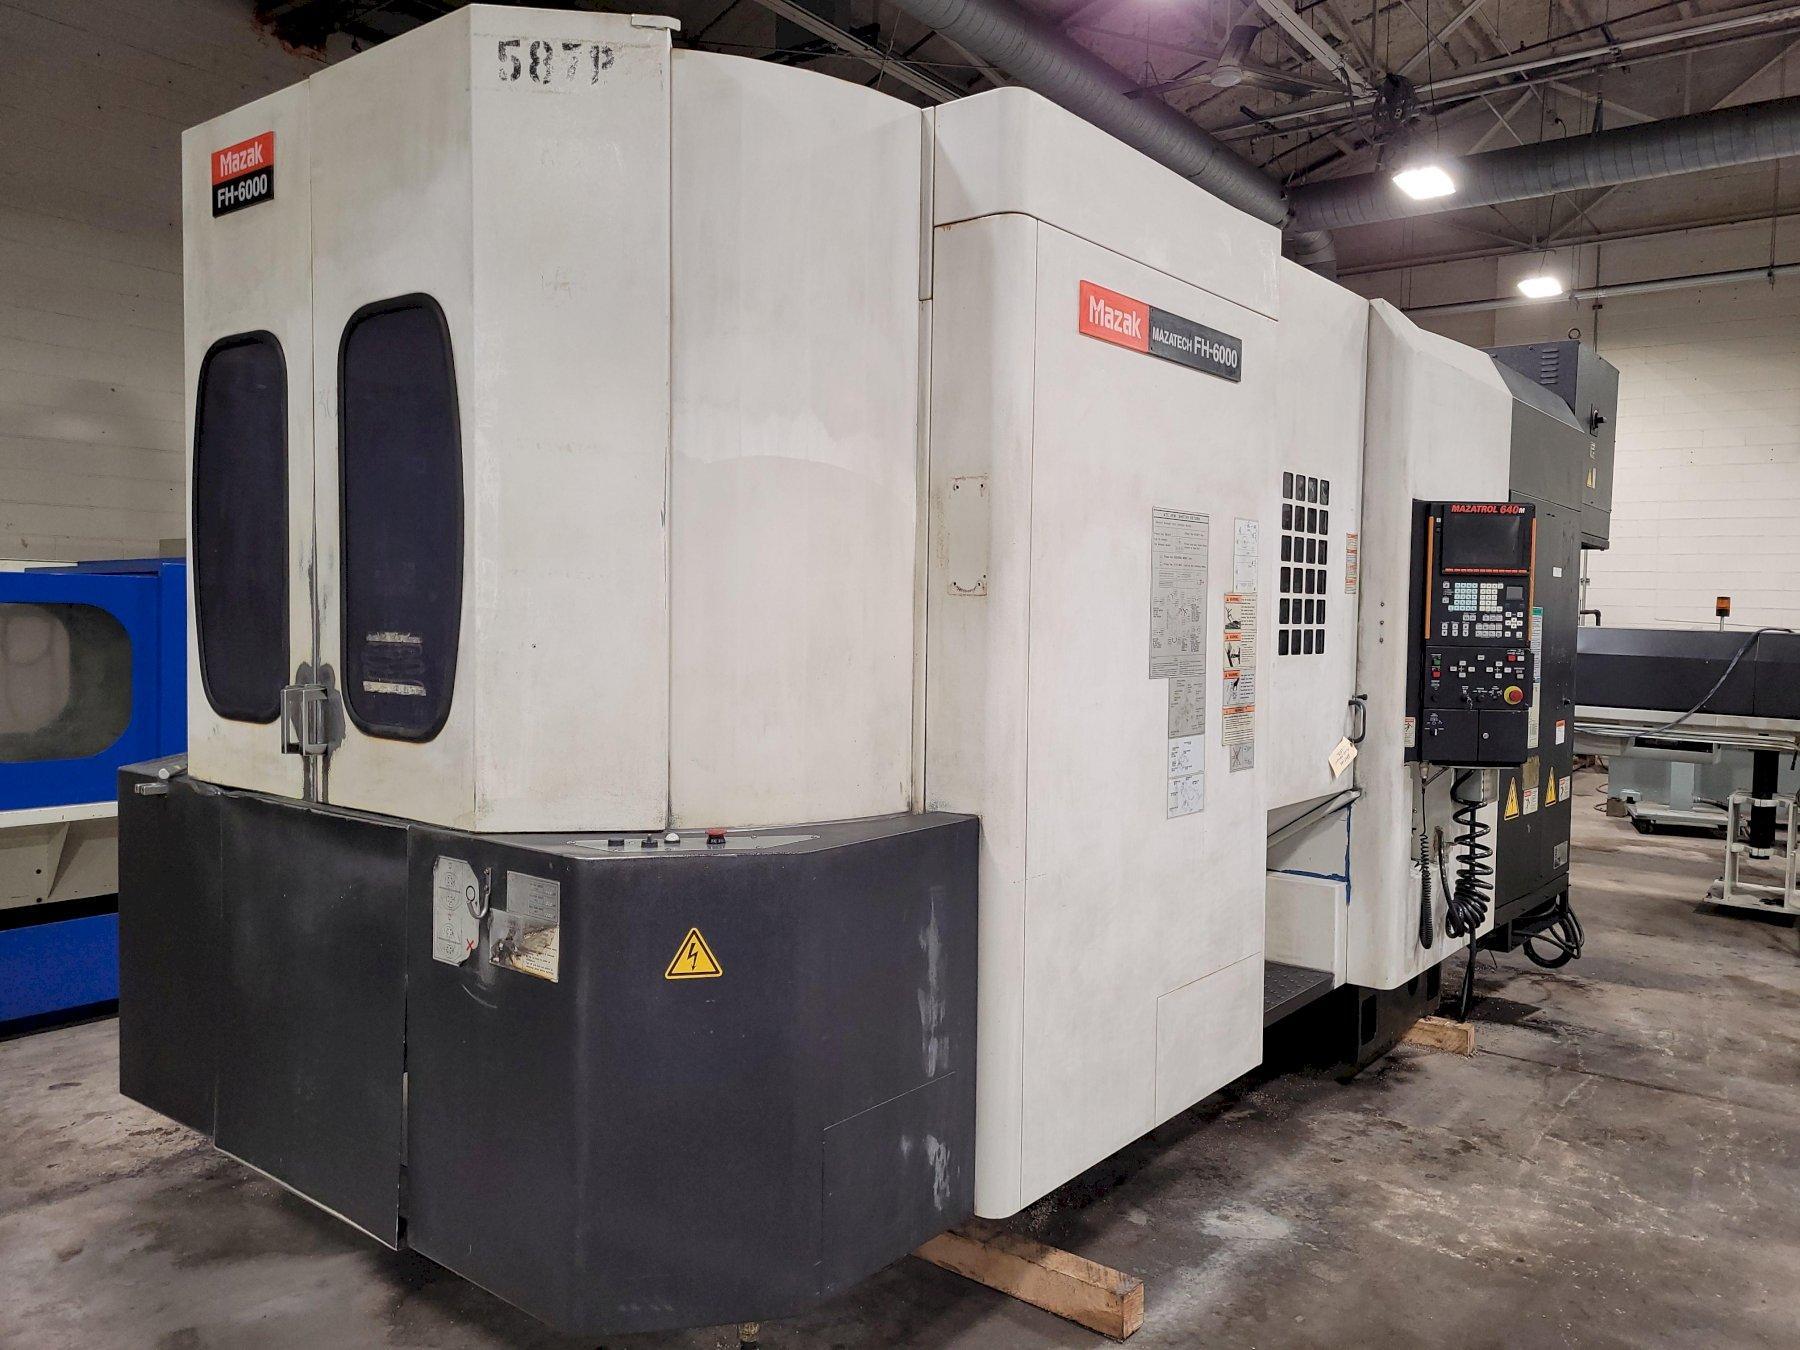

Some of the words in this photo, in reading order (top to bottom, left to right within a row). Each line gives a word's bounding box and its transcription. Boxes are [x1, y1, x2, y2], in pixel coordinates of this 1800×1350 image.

[498, 39, 615, 85] 587P
[220, 141, 264, 177] Mazak
[217, 174, 268, 208] FH-6000
[1089, 295, 1142, 339] Mazak
[1152, 326, 1193, 352] MAZATECH
[1193, 336, 1238, 369] FH-6000
[1451, 504, 1498, 513] MAZATROL
